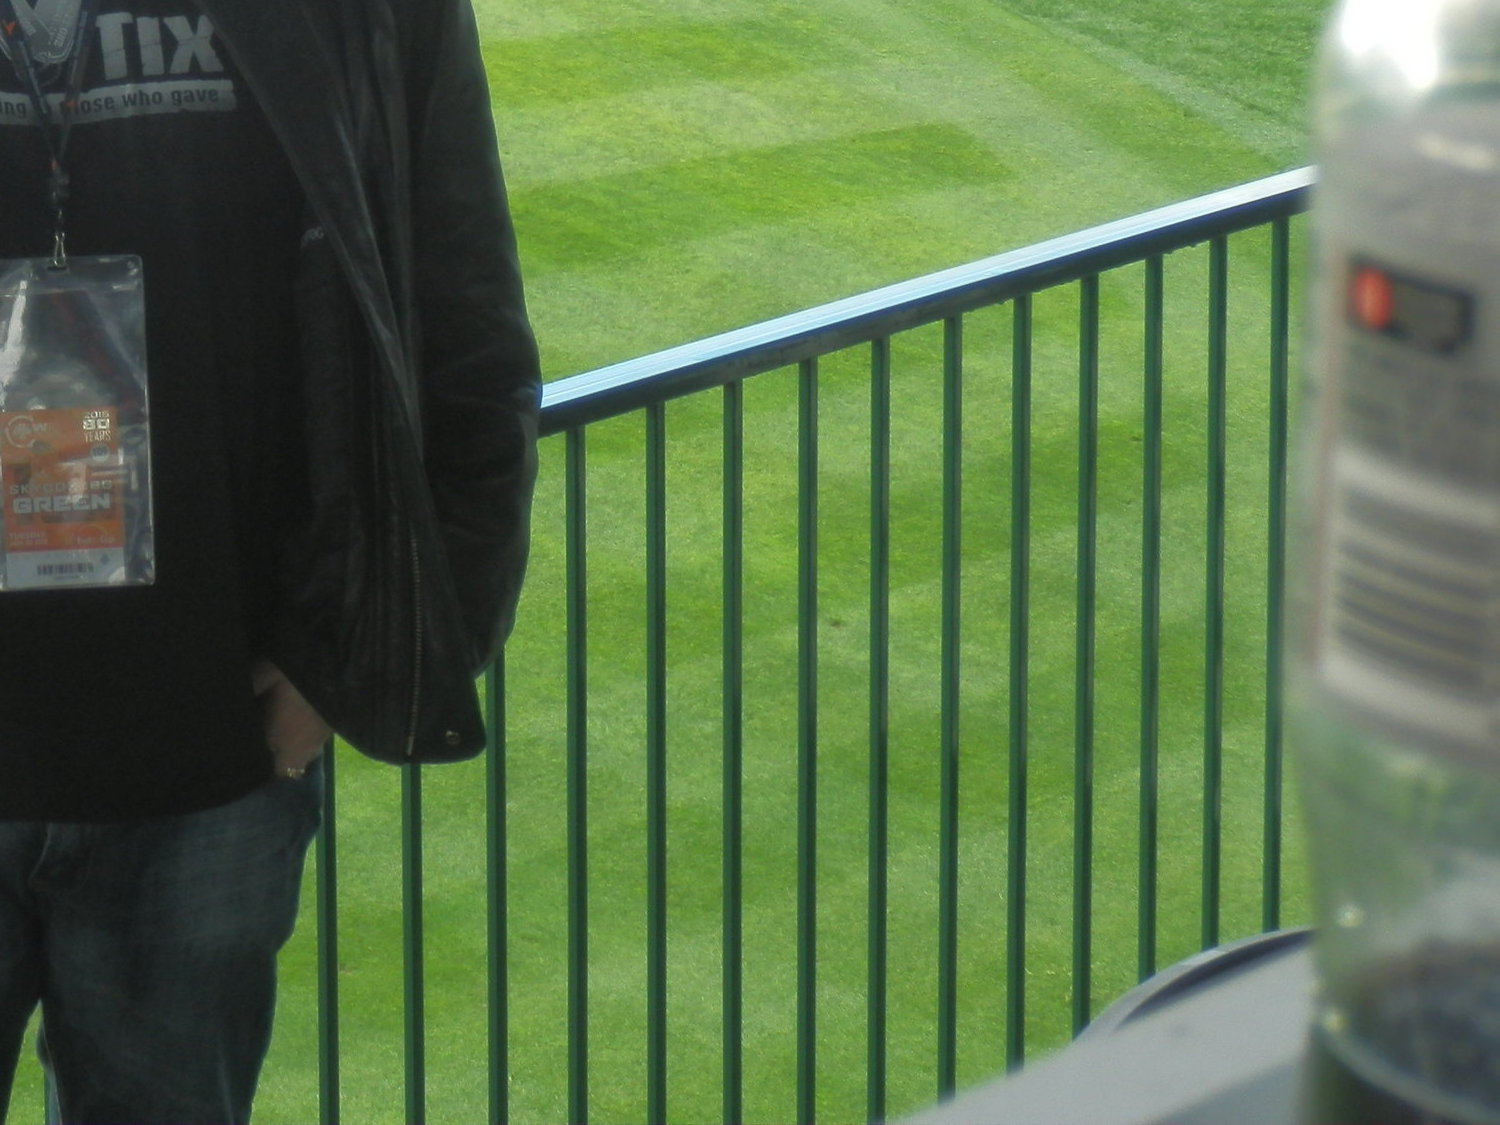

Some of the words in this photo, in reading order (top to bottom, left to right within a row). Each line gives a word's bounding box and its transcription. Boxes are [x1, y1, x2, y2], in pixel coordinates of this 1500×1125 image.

[95, 11, 224, 81] TIX
[122, 89, 163, 108] who
[171, 87, 219, 106] gave
[84, 430, 112, 443] YEARS
[12, 492, 111, 514] GREEN
